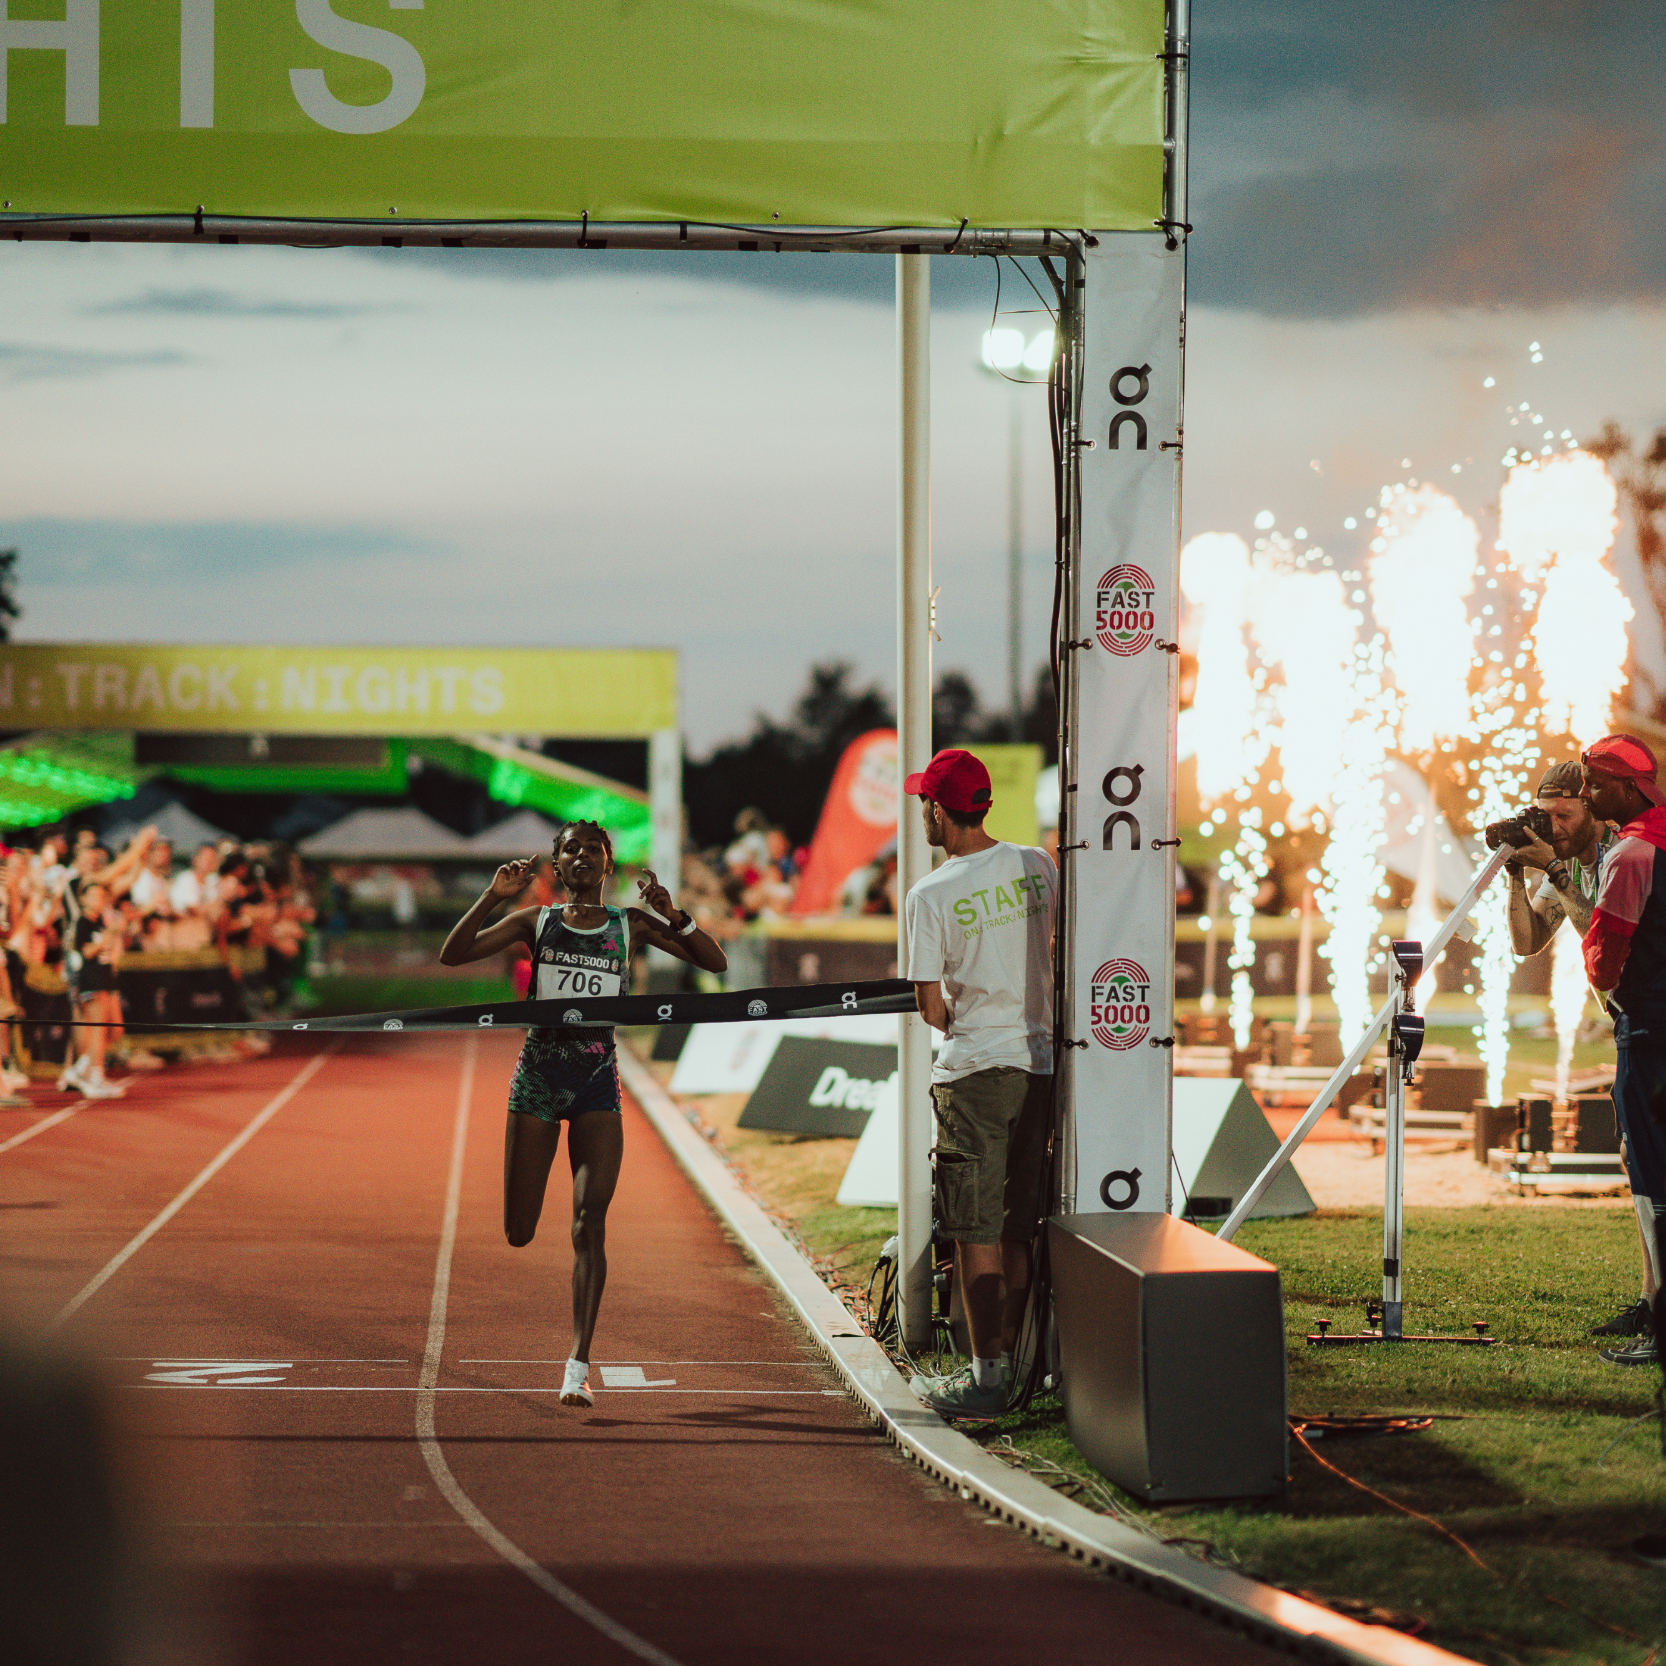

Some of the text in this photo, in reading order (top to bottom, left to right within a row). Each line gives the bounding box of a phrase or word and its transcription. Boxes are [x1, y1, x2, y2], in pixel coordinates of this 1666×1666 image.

[1096, 590, 1155, 609] FAST
[1096, 610, 1155, 631] 5000
[953, 874, 1046, 926] STAFF
[557, 969, 603, 996] 706
[1090, 984, 1151, 1004] FAST
[1090, 1004, 1151, 1025] 5000
